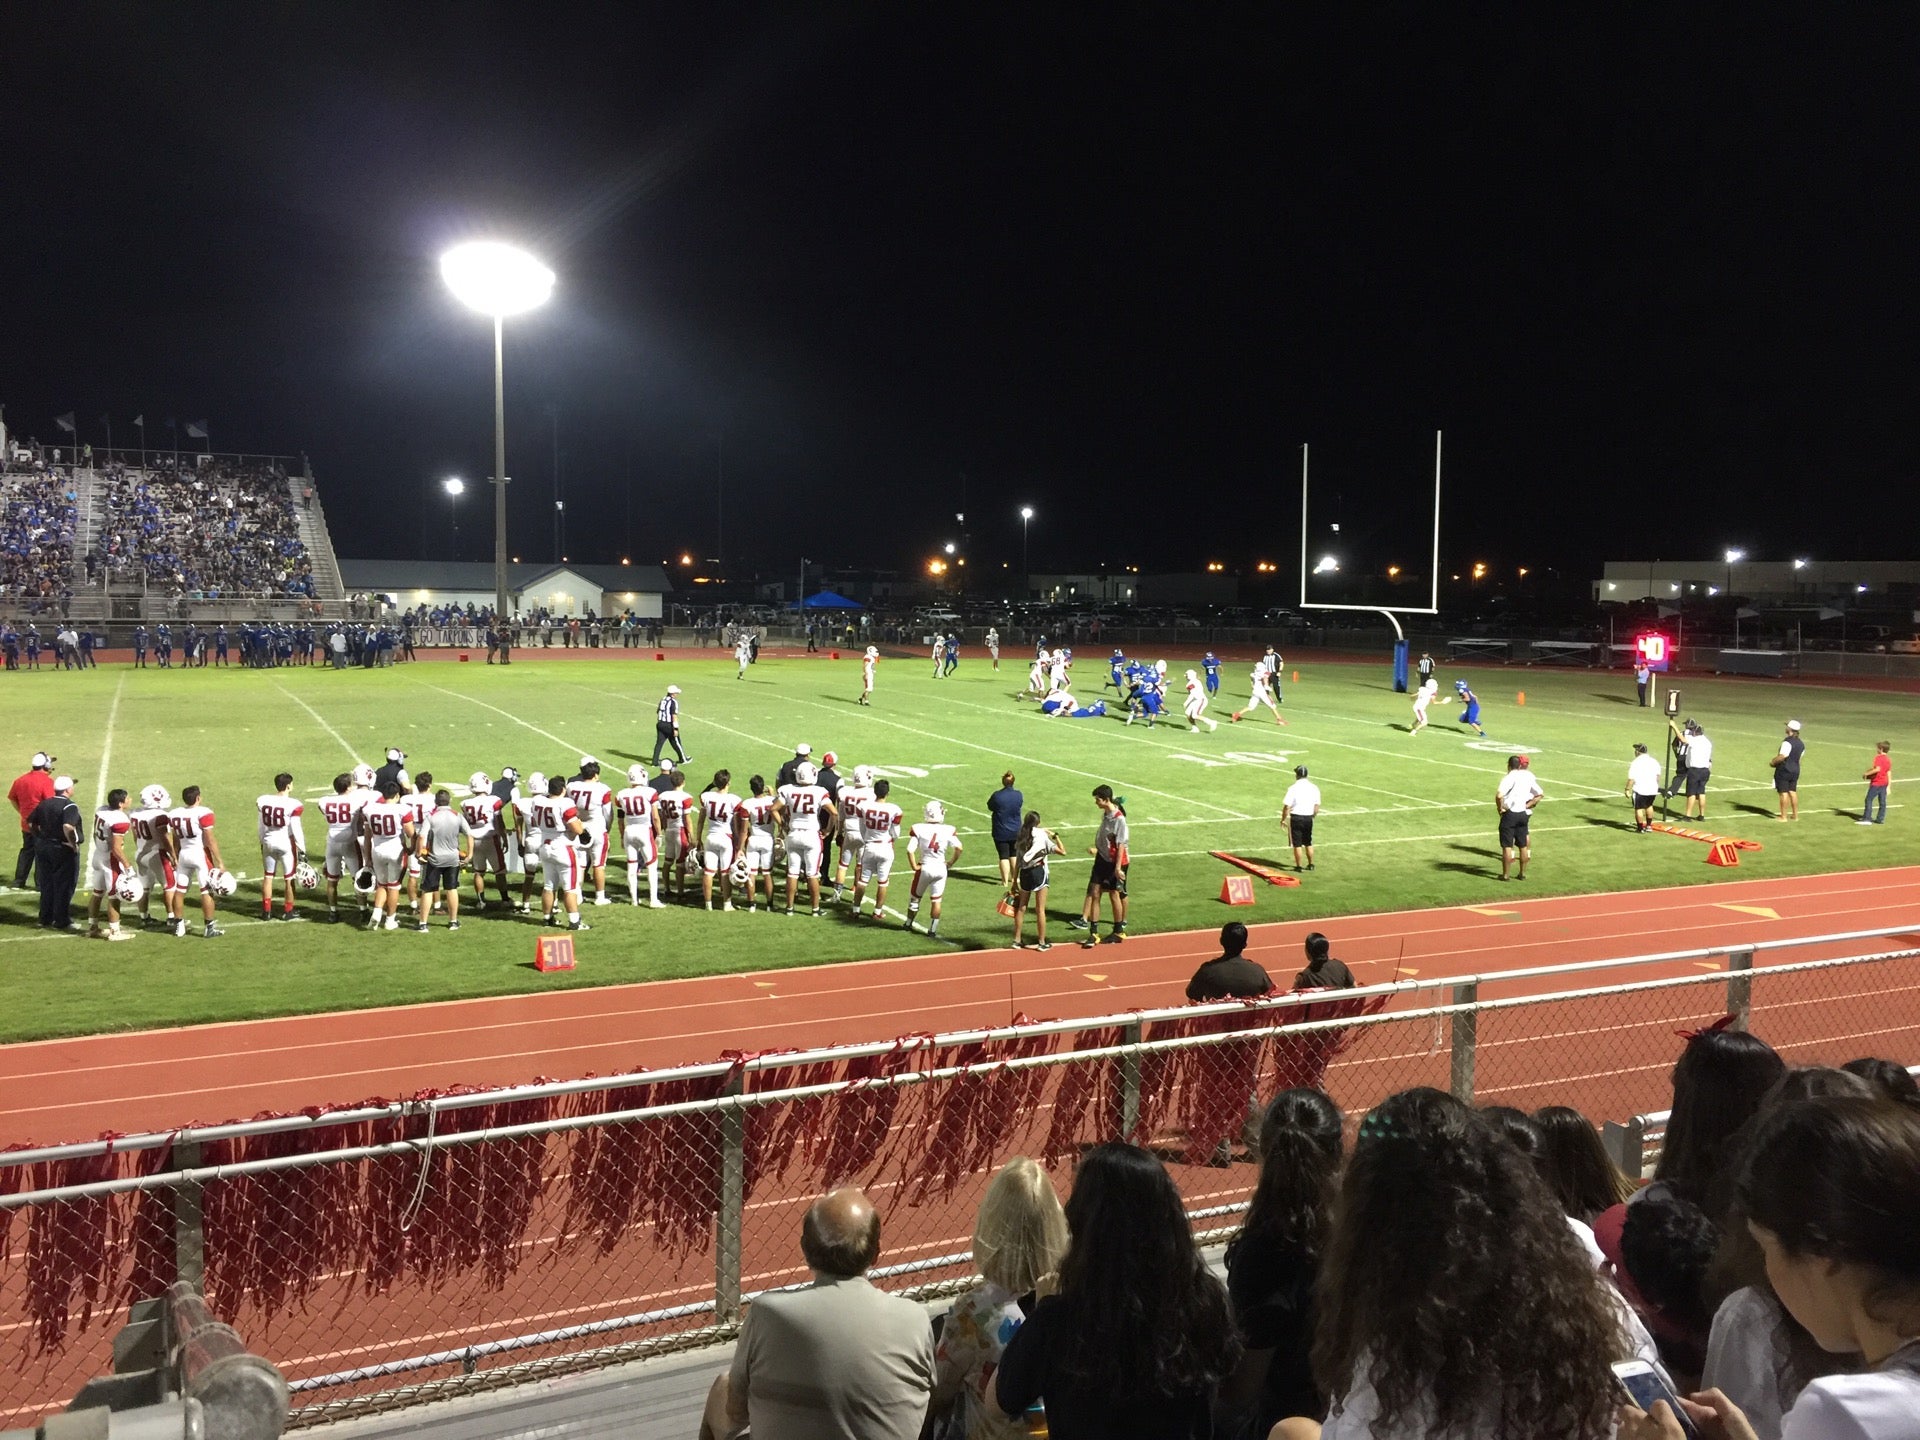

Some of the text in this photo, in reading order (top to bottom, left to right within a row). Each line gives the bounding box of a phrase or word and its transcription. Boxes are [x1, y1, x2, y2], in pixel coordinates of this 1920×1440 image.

[420, 629, 432, 643] GO
[1638, 636, 1665, 661] 40
[1669, 692, 1677, 711] 1
[571, 790, 592, 811] 77
[623, 796, 645, 816] 10
[709, 801, 728, 822] 14
[791, 793, 815, 814] 72
[261, 805, 286, 828] 88
[325, 802, 351, 824] 58
[534, 805, 556, 828] 76
[865, 809, 890, 831] 52
[172, 817, 197, 839] 81
[370, 814, 396, 836] 60
[928, 832, 940, 854] 4
[1720, 844, 1738, 863] 10
[1229, 879, 1253, 901] 20
[543, 939, 572, 967] 30
